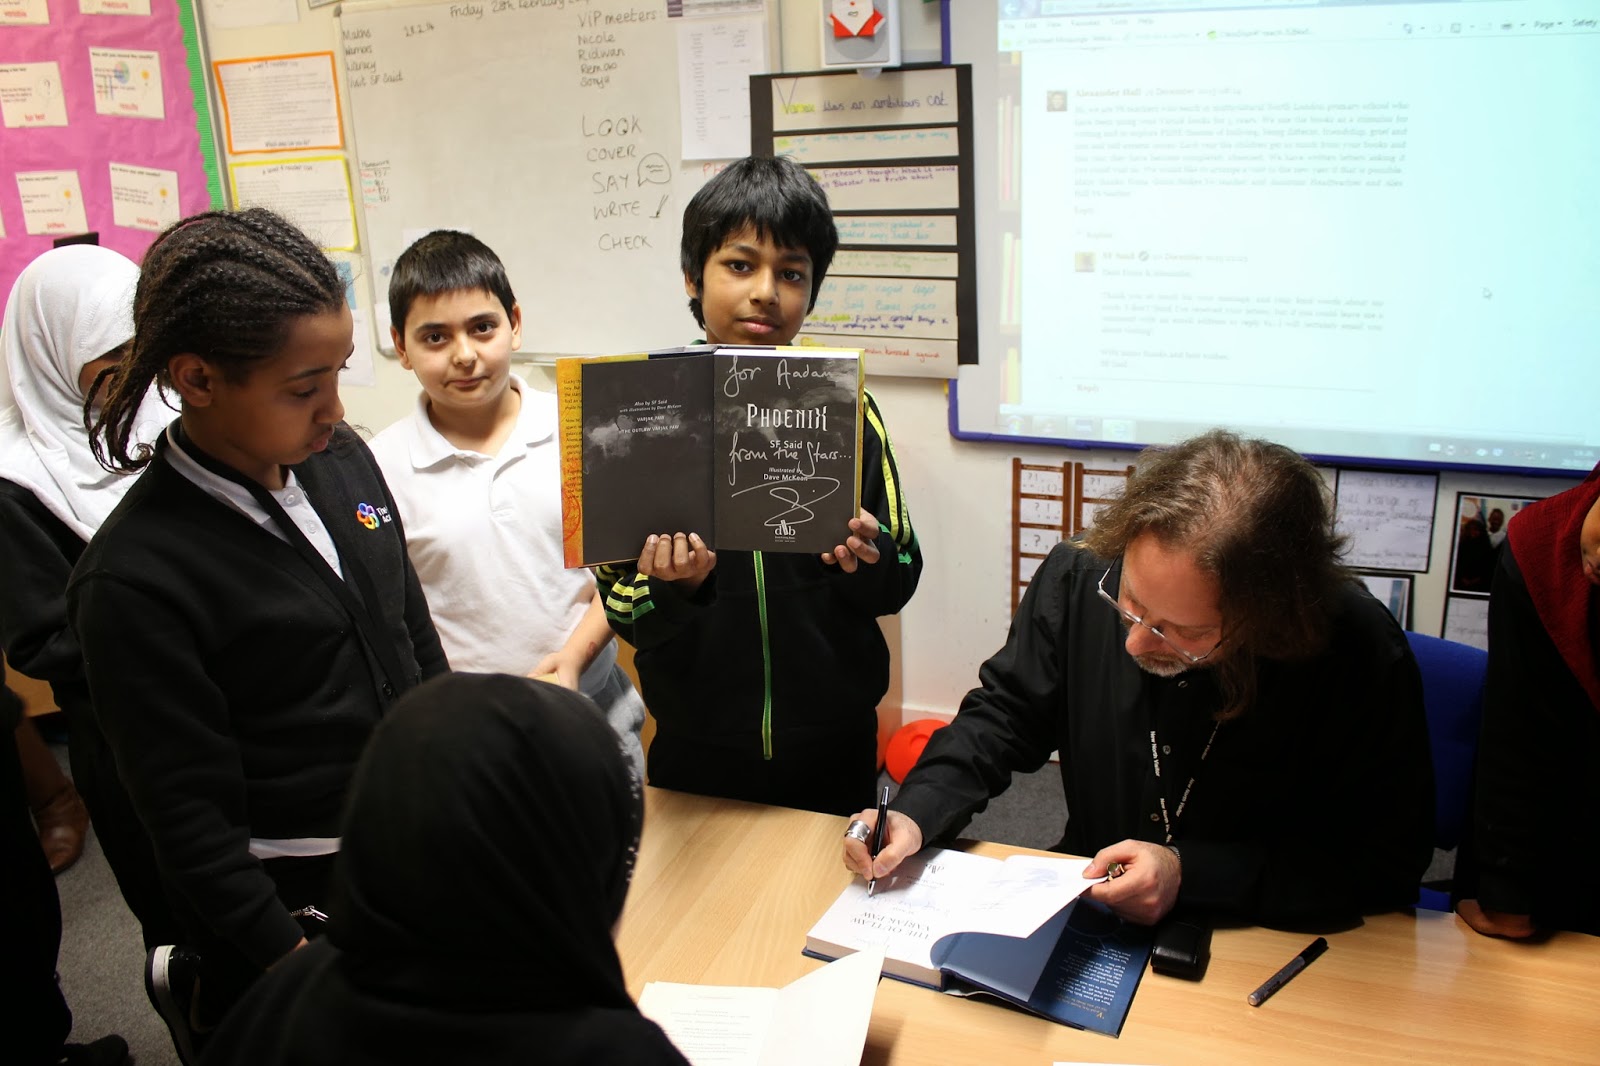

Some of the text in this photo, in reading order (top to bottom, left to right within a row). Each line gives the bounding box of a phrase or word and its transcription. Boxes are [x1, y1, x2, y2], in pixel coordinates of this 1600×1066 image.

[578, 32, 616, 46] Nicole
[578, 48, 626, 61] Ridwan
[587, 144, 637, 162] COVER
[592, 171, 629, 195] SAY
[593, 199, 641, 221] WRITE
[598, 233, 653, 251] CHECK
[747, 403, 827, 431] PHOENIX
[770, 440, 803, 448] SF Said
[728, 431, 768, 486] from
[773, 447, 799, 460] the
[1153, 759, 1161, 777] Visitor
